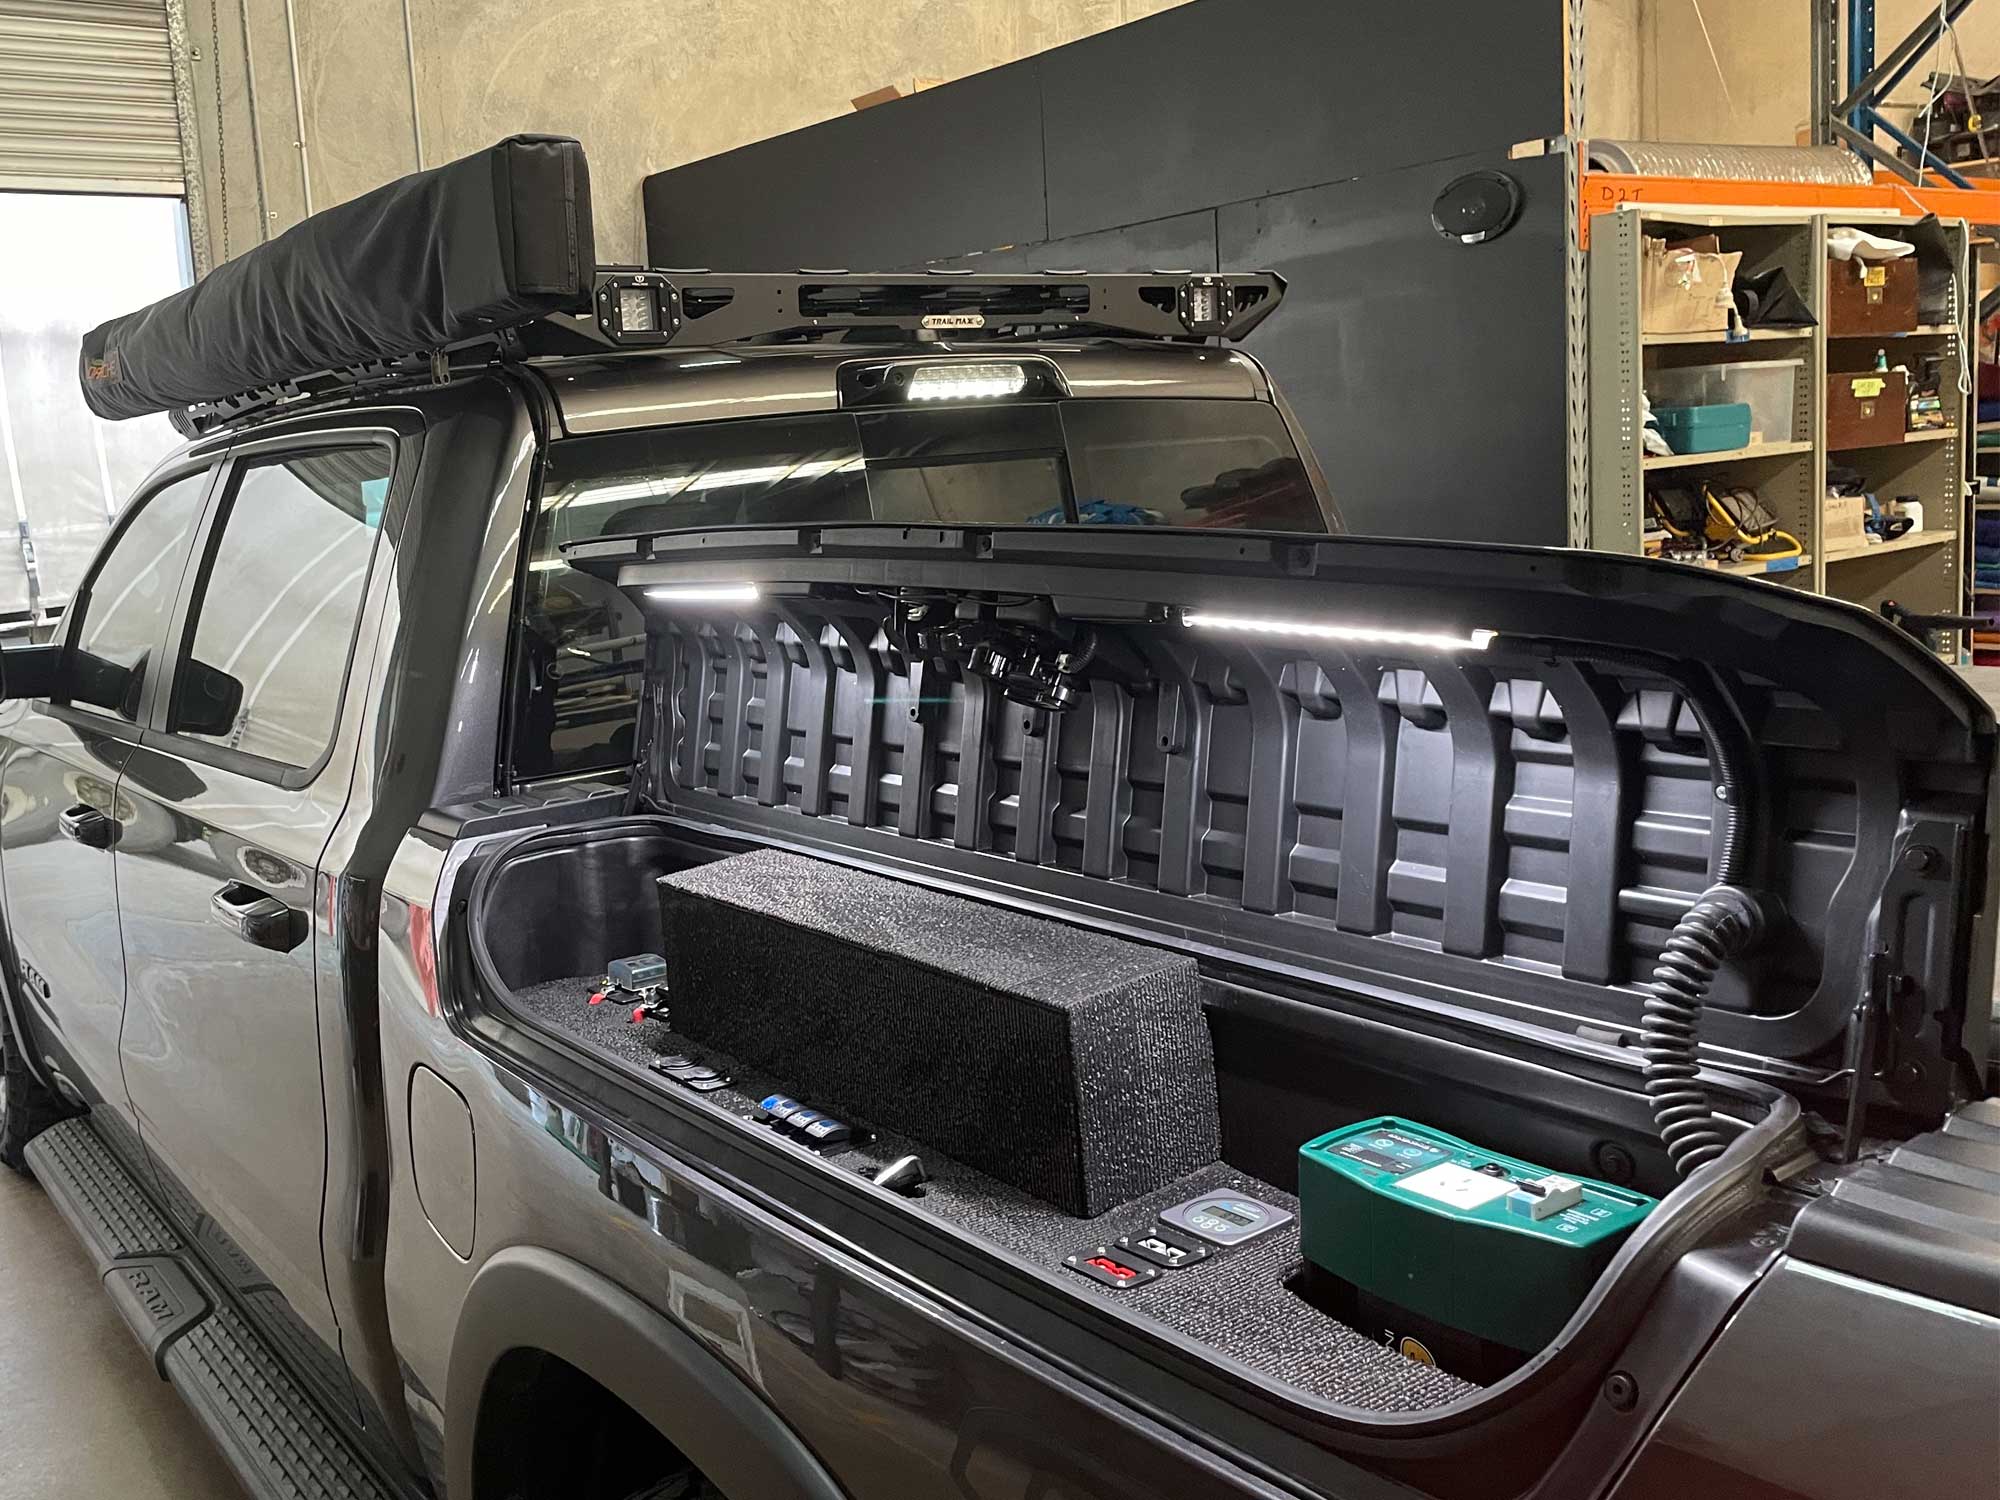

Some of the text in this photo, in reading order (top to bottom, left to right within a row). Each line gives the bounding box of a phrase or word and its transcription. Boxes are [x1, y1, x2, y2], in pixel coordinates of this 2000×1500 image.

[931, 318, 975, 326] TRAIL MAX
[129, 1269, 175, 1321] RAM
